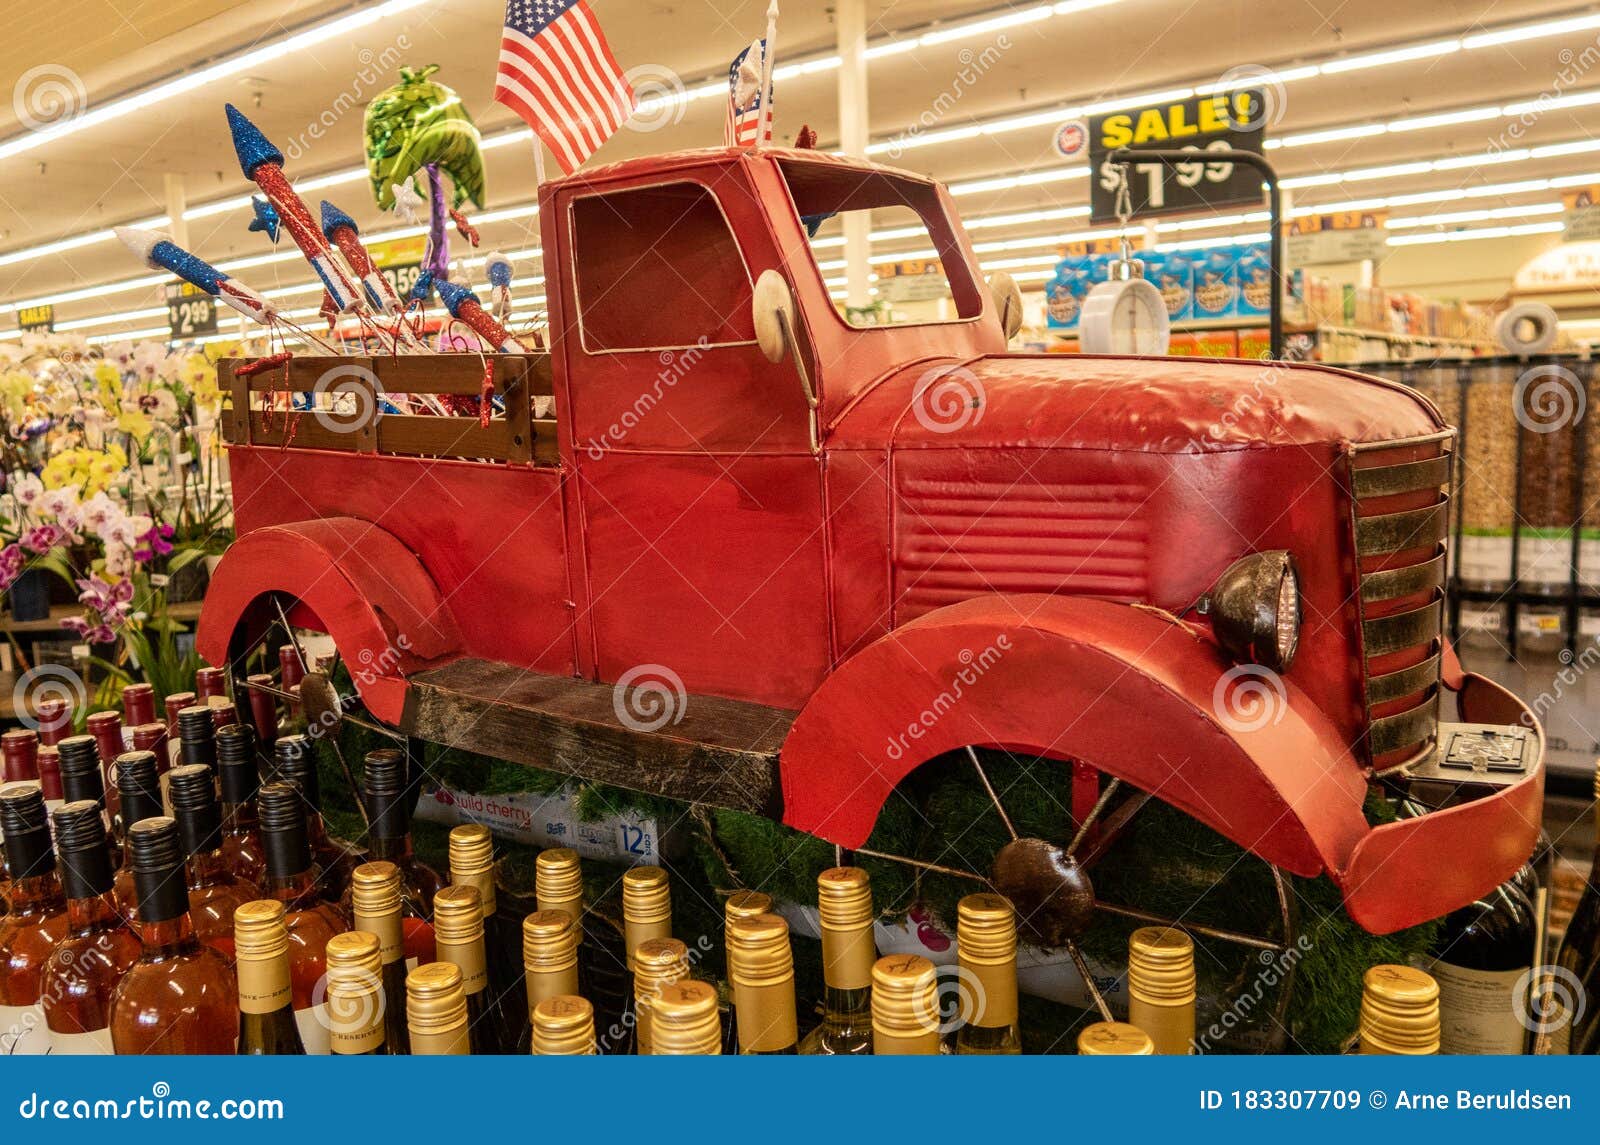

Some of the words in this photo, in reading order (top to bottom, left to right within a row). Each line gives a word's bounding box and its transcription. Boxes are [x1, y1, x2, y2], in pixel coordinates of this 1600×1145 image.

[1101, 93, 1251, 148] SALE!
[457, 796, 483, 812] wild
[486, 801, 531, 826] cherry
[620, 824, 645, 855] 12
[338, 1028, 378, 1040] RESERVE
